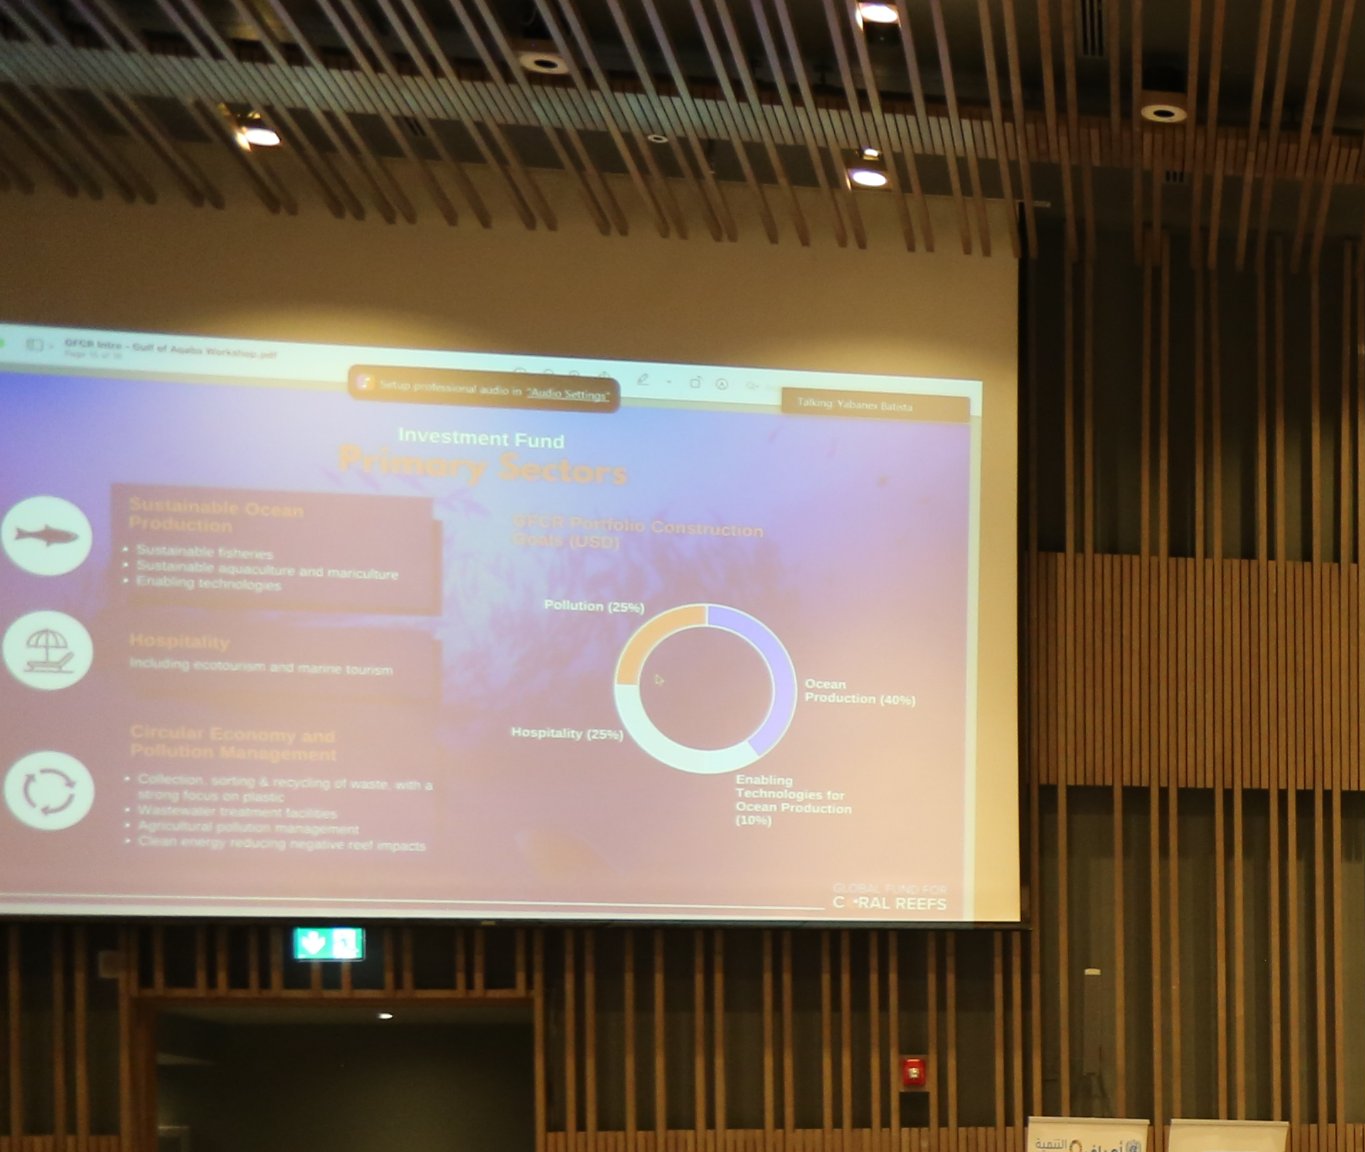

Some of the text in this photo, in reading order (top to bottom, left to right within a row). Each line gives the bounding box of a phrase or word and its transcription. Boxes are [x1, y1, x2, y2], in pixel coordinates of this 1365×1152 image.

[379, 379, 408, 390] Setup
[412, 381, 475, 394] professional
[478, 385, 508, 395] audio
[511, 386, 521, 395] in
[398, 426, 564, 449] Investment Fund
[339, 444, 627, 486] Primary Sectors
[128, 497, 304, 518] Sustainable Ocean
[128, 515, 233, 533] Production
[569, 516, 764, 537] Portfolio Construction
[568, 534, 619, 551] (USD)
[136, 543, 274, 560] Sustainable fisheries
[136, 559, 398, 580] Sustainable aquaculture and mariculture
[137, 575, 281, 593] Enabling technologies
[544, 599, 645, 614] Pollution (25%)
[131, 632, 229, 652] Hospitality
[131, 655, 189, 671] Including
[268, 661, 293, 672] and
[345, 663, 393, 675] tourism
[805, 678, 846, 691] Ocean
[805, 691, 915, 708] Production (40%)
[129, 724, 334, 745] Circular Economy and
[511, 726, 624, 743] Hospitality (25%)
[129, 742, 335, 764] Pollution Management
[736, 773, 793, 788] Enabling
[736, 786, 844, 801] Technologies for
[736, 801, 851, 815] Ocean Production
[736, 814, 772, 827] (10%)
[894, 896, 946, 911] REEFS
